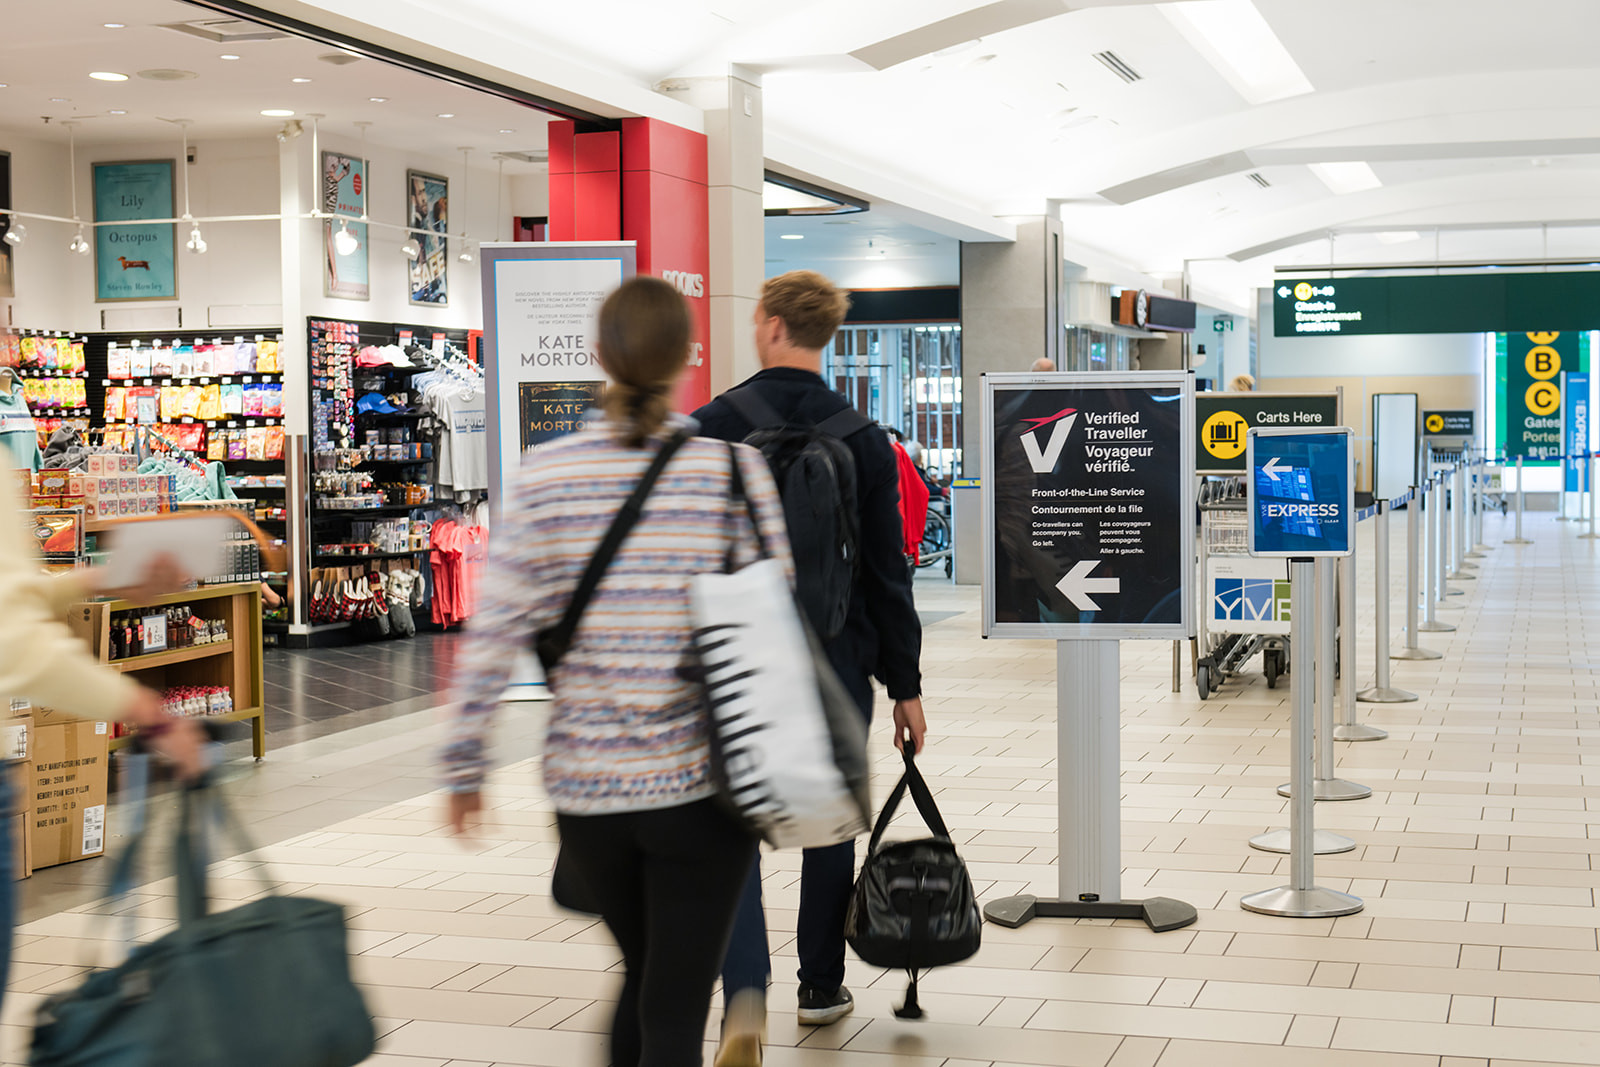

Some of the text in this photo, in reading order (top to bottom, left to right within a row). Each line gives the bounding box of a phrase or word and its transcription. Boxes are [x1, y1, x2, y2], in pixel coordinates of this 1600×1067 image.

[121, 195, 144, 210] Lily
[109, 231, 158, 245] Octopus
[107, 283, 132, 291] Steven
[539, 335, 584, 349] KATE
[1534, 353, 1552, 372] B
[1534, 389, 1552, 408] C
[544, 404, 584, 414] KATE
[1084, 411, 1139, 425] Verified
[1256, 411, 1322, 423] Carts Here
[1524, 416, 1560, 428] Gates
[1084, 427, 1148, 440] Traveller
[1085, 445, 1154, 460] Voyageur
[1031, 487, 1145, 497] Front-of-the-Line Service
[1031, 505, 1143, 514] Contournement de la file
[1268, 504, 1339, 517] EXPRESS
[49, 759, 81, 770] MANUFACTURING
[37, 791, 52, 800] MEMORY
[53, 789, 64, 797] FOAM
[37, 816, 68, 828] MADE IN CHINA
